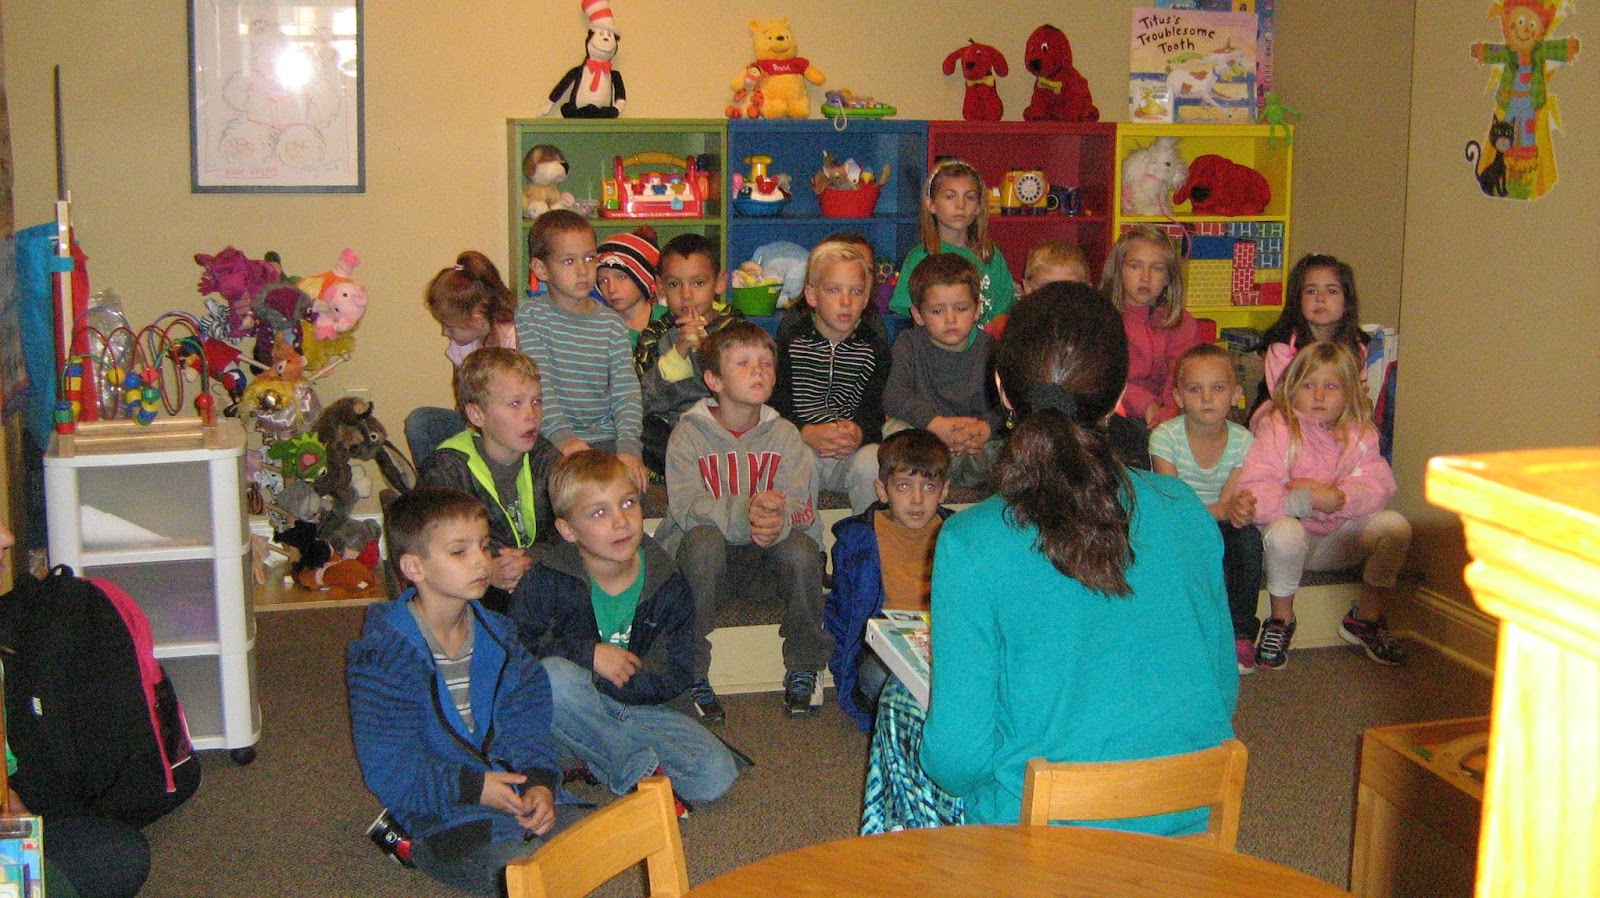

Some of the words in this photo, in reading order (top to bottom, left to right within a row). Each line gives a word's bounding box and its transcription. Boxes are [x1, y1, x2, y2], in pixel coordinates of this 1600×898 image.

[1138, 14, 1181, 30] Titus's
[1136, 26, 1216, 47] Troublesome
[1157, 38, 1195, 54] Tooth
